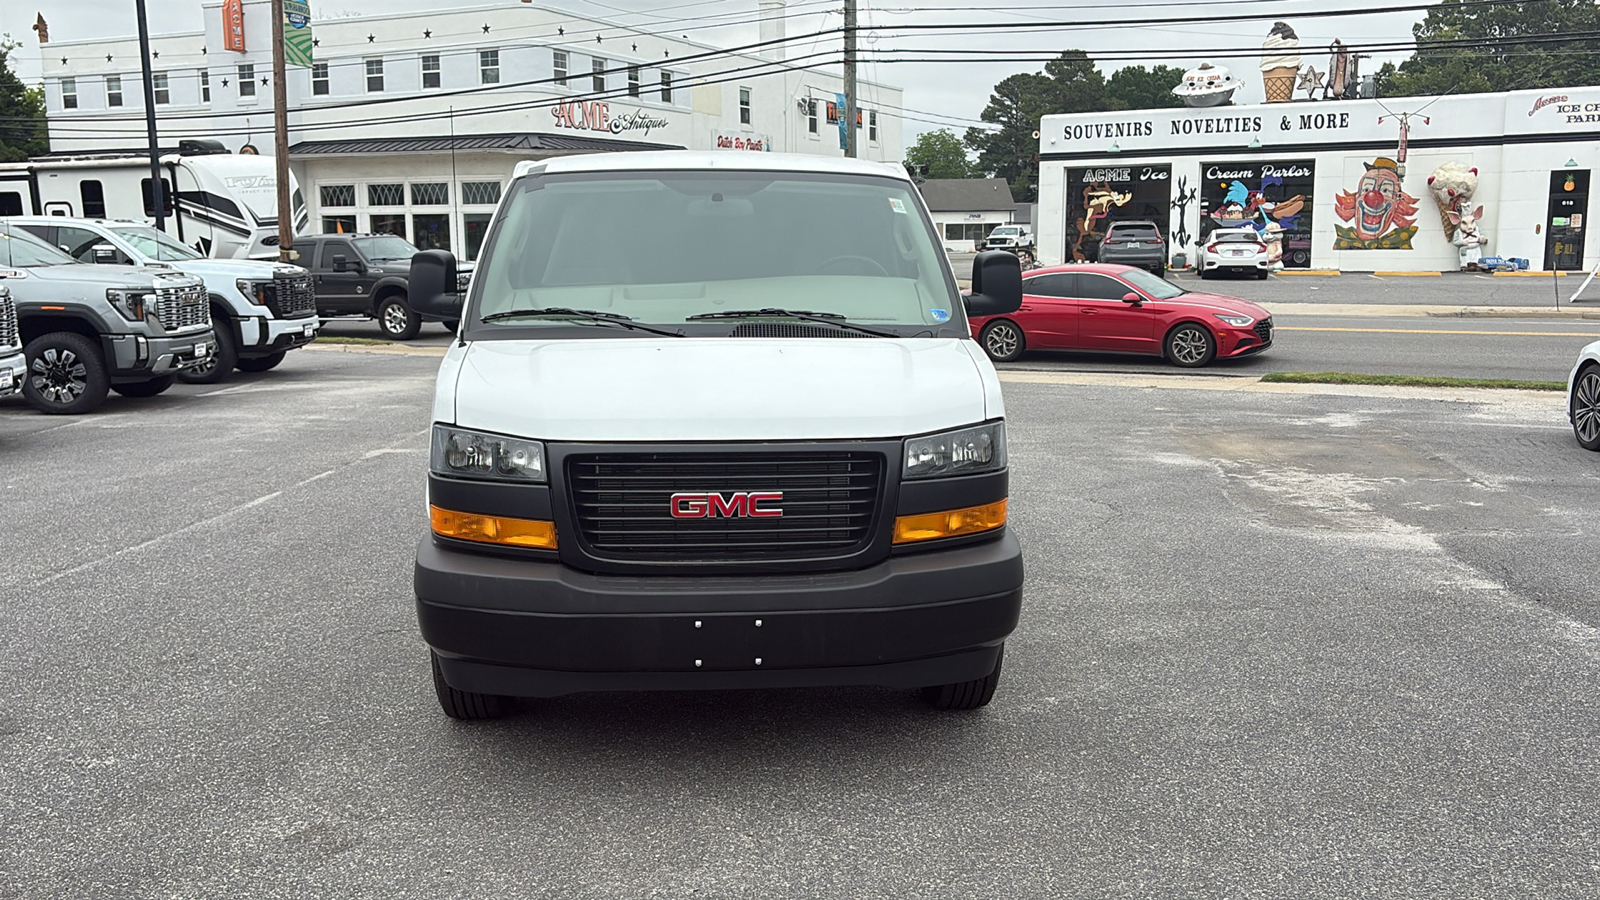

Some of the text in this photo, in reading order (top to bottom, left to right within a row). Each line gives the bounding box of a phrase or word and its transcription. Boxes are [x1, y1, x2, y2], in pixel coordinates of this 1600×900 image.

[232, 2, 242, 48] ACME
[551, 98, 611, 132] ACME
[1556, 104, 1581, 113] ICE
[1064, 113, 1350, 140] SOUVENIRS NOVELTIES & MORE
[717, 135, 763, 152] Dutch Boy Paints
[1082, 167, 1169, 183] ACME Ice
[1206, 165, 1312, 180] Cream Parlor
[670, 491, 784, 518] GMC
